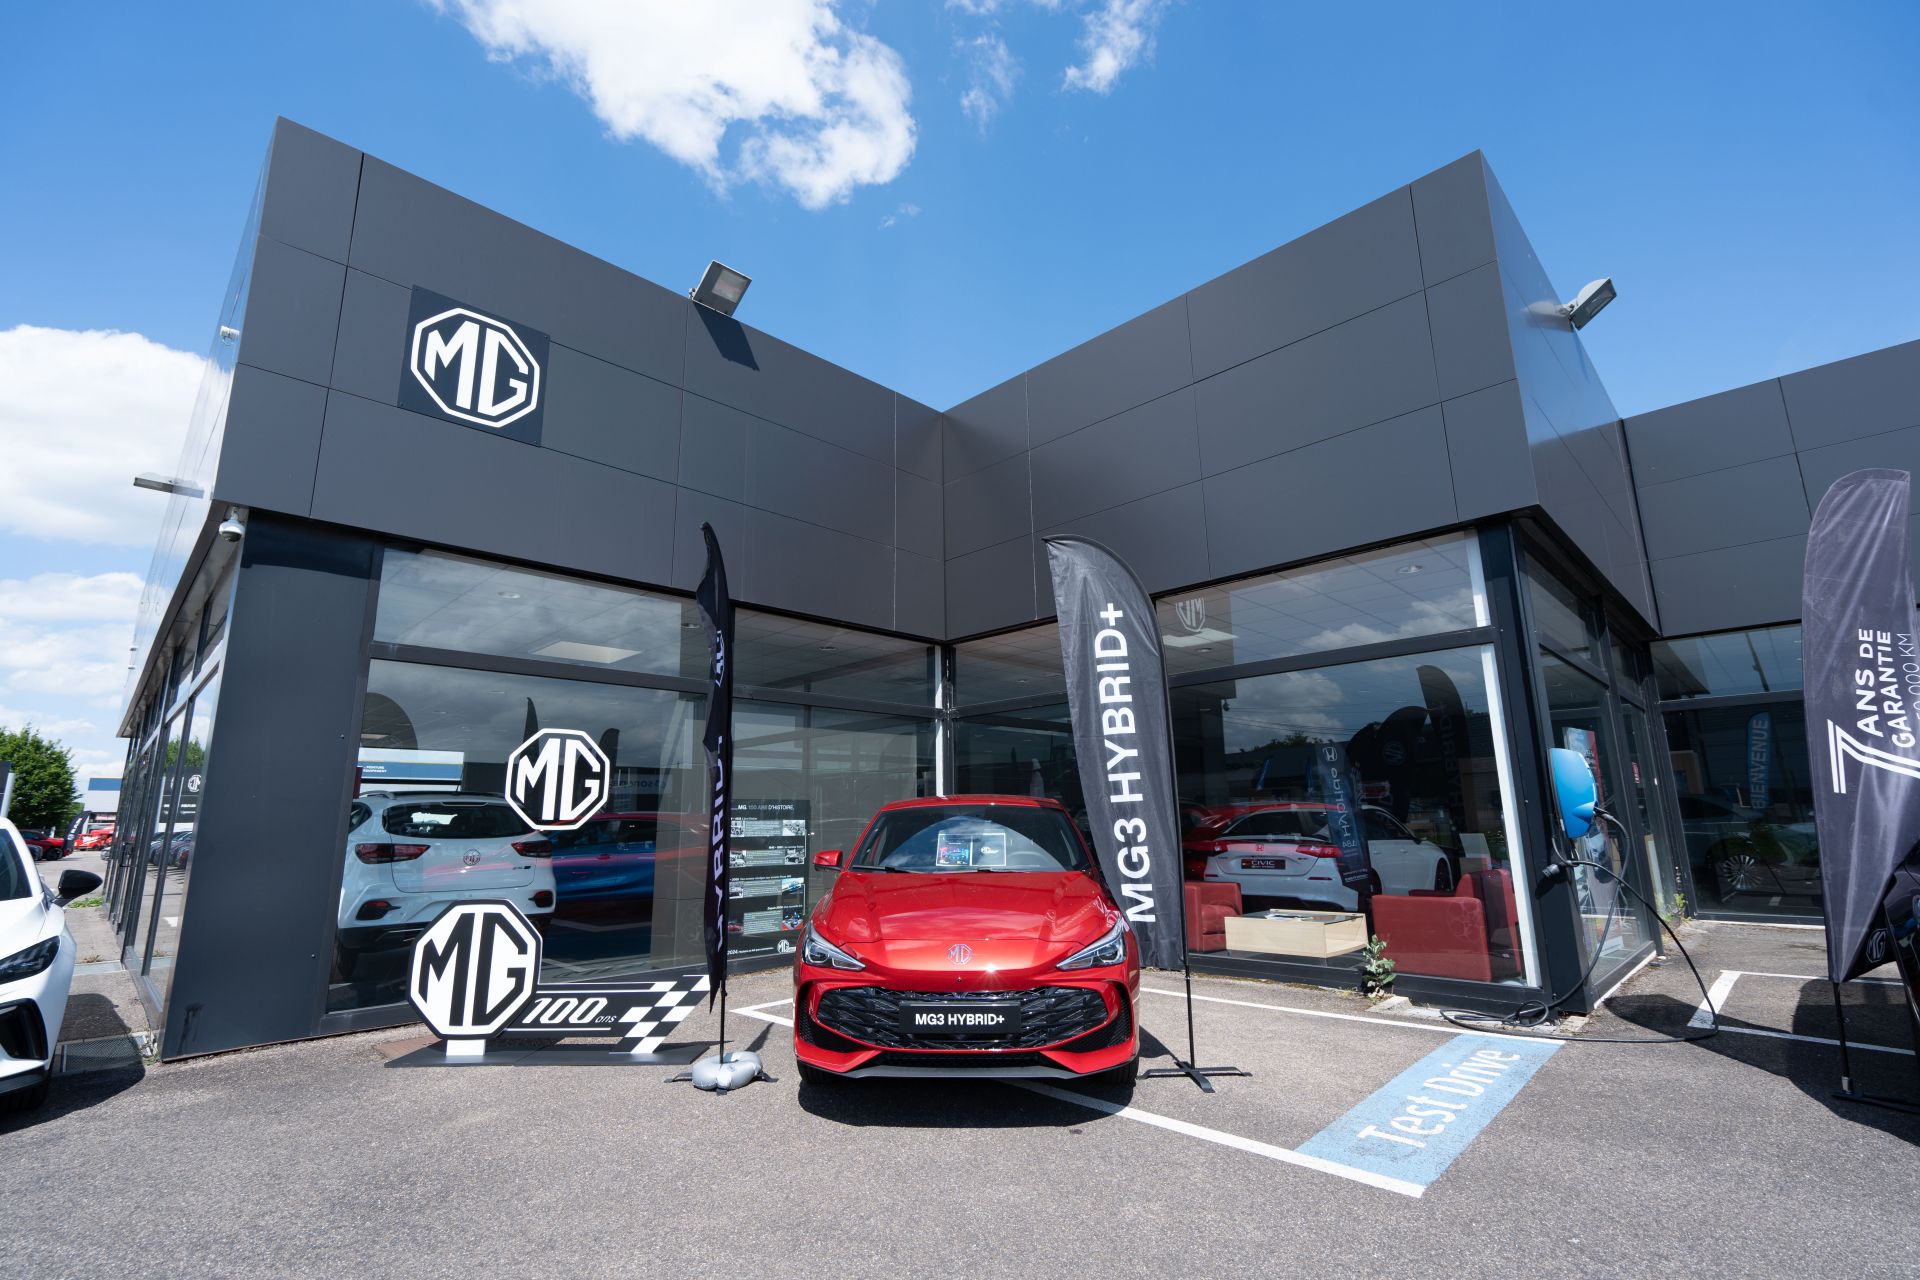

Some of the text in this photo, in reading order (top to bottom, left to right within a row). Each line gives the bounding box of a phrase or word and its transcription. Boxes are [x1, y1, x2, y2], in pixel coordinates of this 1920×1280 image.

[423, 319, 529, 418] MG
[1855, 628, 1885, 738] ANS DE
[1876, 630, 1917, 749] GARANTIE
[1896, 632, 1917, 658] KM
[514, 736, 602, 822] MG
[1094, 602, 1157, 924] MG3 HYBRID+
[1750, 719, 1769, 809] BIENVENUE
[1827, 718, 1920, 795] 7
[418, 911, 529, 1027] MG
[948, 944, 972, 965] MG
[522, 997, 618, 1024] 100 ans
[915, 1013, 1006, 1026] MG3 HYBRID+
[1356, 1049, 1521, 1149] Test Drive
